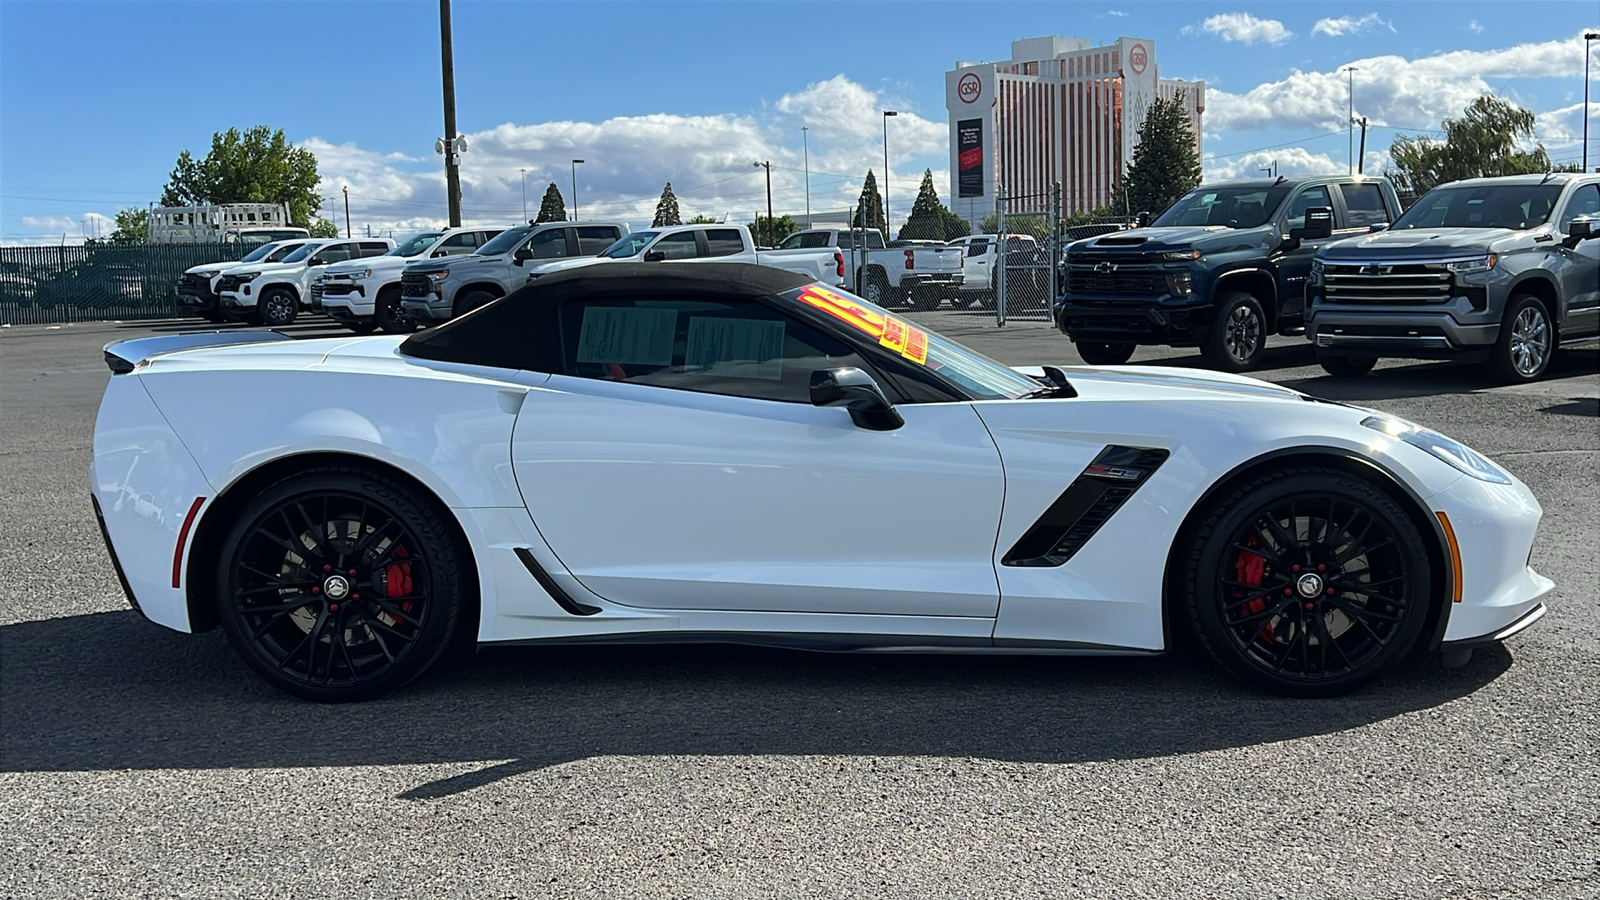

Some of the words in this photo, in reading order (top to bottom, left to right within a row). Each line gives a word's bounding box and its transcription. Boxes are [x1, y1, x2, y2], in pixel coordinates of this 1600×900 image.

[1133, 53, 1145, 65] GSR
[961, 82, 978, 95] GSR
[802, 286, 885, 338] 15
